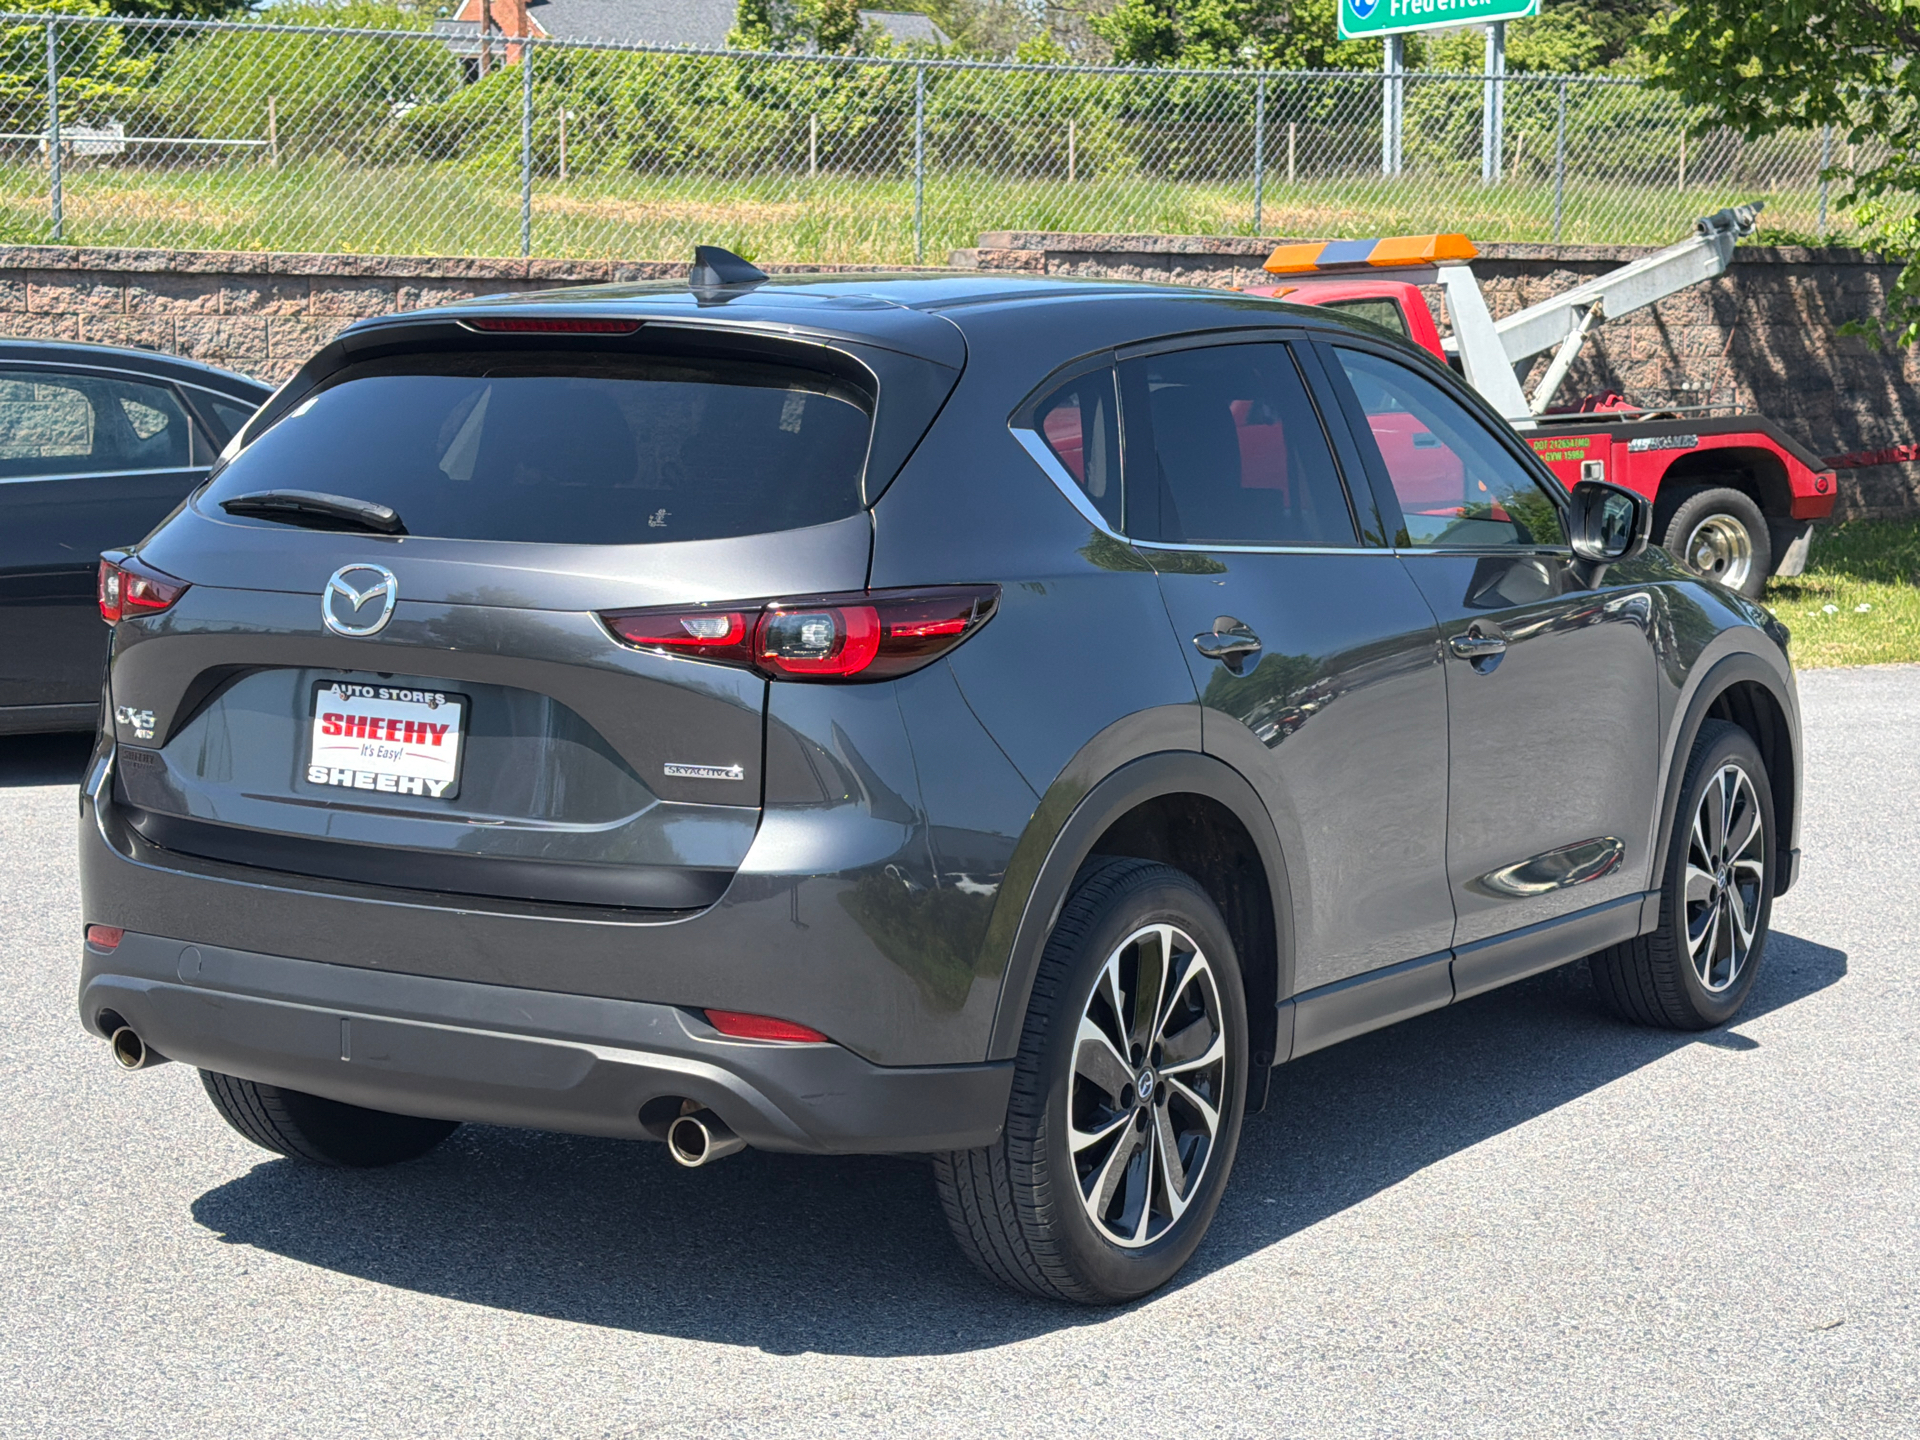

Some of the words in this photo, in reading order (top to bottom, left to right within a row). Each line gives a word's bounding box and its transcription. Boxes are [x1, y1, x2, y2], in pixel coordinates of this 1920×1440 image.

[1390, 0, 1491, 17] Freder
[331, 683, 374, 698] AUTO
[379, 688, 446, 704] STORES
[322, 712, 450, 747] SHEEHY
[361, 744, 375, 757] It's
[377, 745, 404, 762] Easy!
[308, 766, 451, 797] SHEEHY
